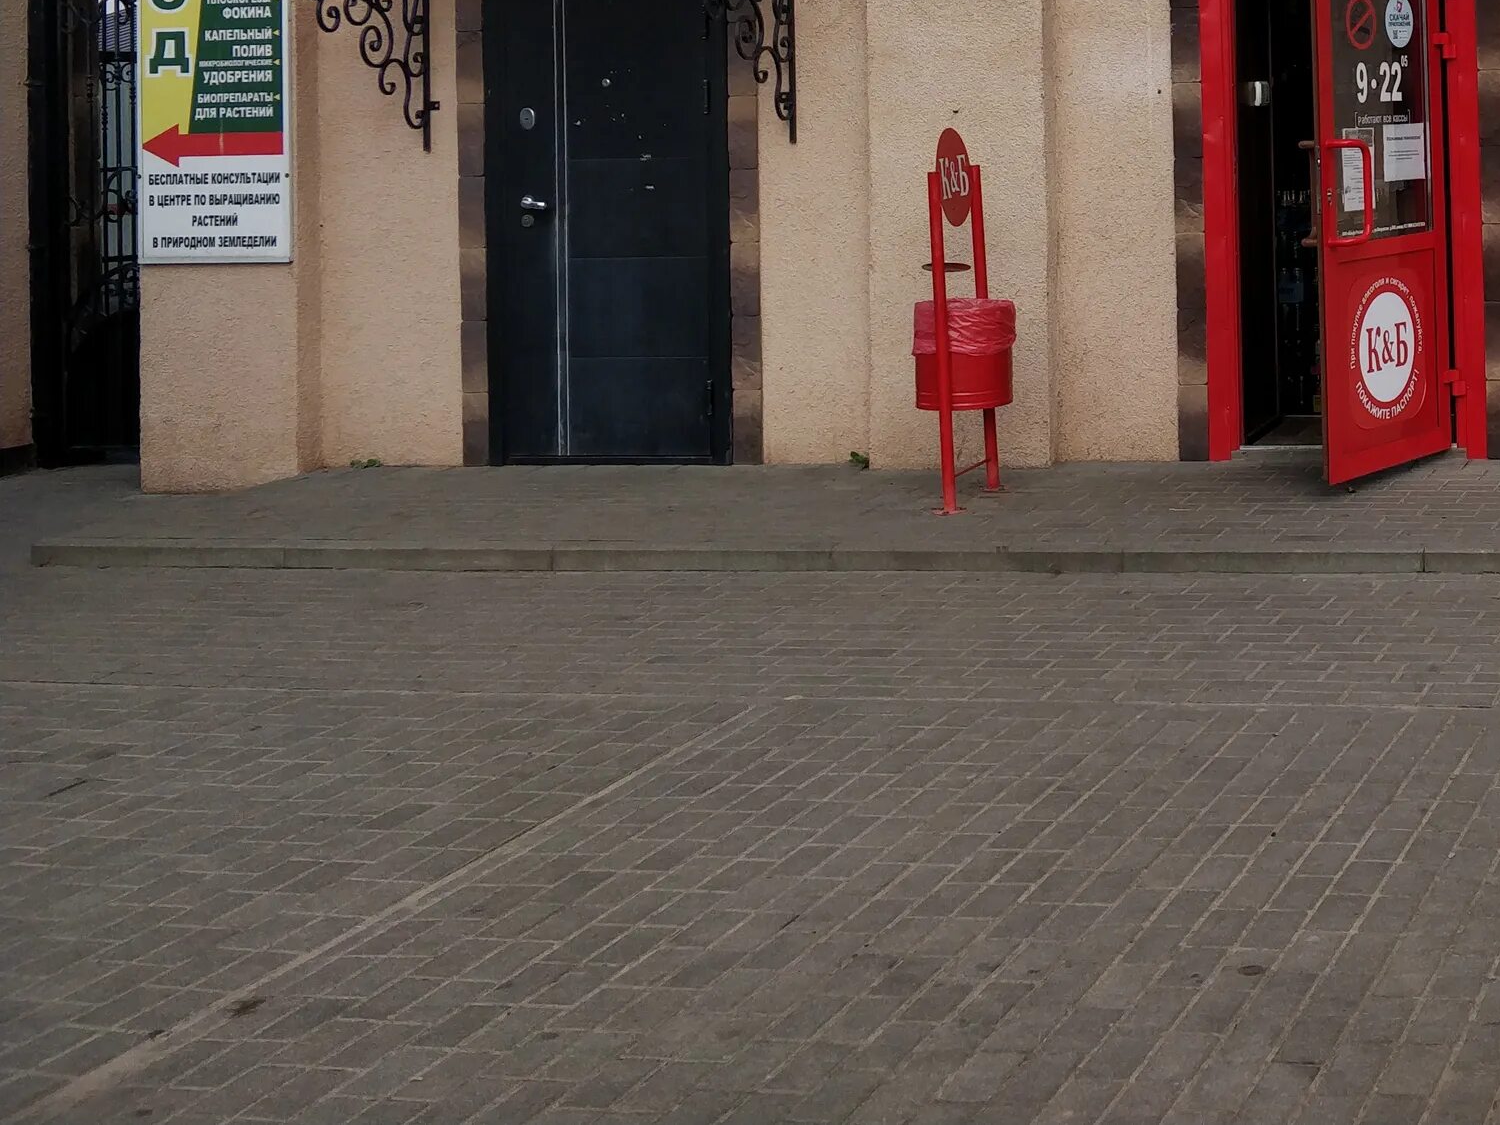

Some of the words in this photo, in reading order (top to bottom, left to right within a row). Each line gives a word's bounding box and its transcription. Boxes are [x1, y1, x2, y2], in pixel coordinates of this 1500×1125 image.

[222, 6, 272, 19] ФОКИНА
[204, 25, 273, 42] КАПЕЛЬНЫЙ
[232, 44, 273, 58] ПОЛИВ
[202, 70, 273, 86] УДОБРЕНИЯ
[197, 92, 274, 104] БИОПРЕПАРАТЫ
[194, 107, 217, 121] ДЛЯ
[219, 104, 274, 118] РАСТЕНИЙ
[148, 173, 209, 186] БЕСПЛАТНЫЕ
[211, 171, 281, 186] КОНСУЛЬТАЦИИ
[939, 154, 970, 200] К&Б
[148, 195, 155, 207] В
[157, 194, 192, 208] ЦЕНТРЕ
[194, 194, 206, 206] ПО
[208, 193, 281, 207] ВЫРАЩИВАНИЮ
[191, 212, 239, 227] РАСТЕНИЙ
[152, 236, 159, 249] В
[160, 236, 216, 250] ПРИРОДНОМ
[219, 235, 278, 250] ЗЕМЛЕДЕЛИИ
[1365, 321, 1409, 374] К&Б
[1355, 380, 1391, 420] ПОКАЖИТЕ
